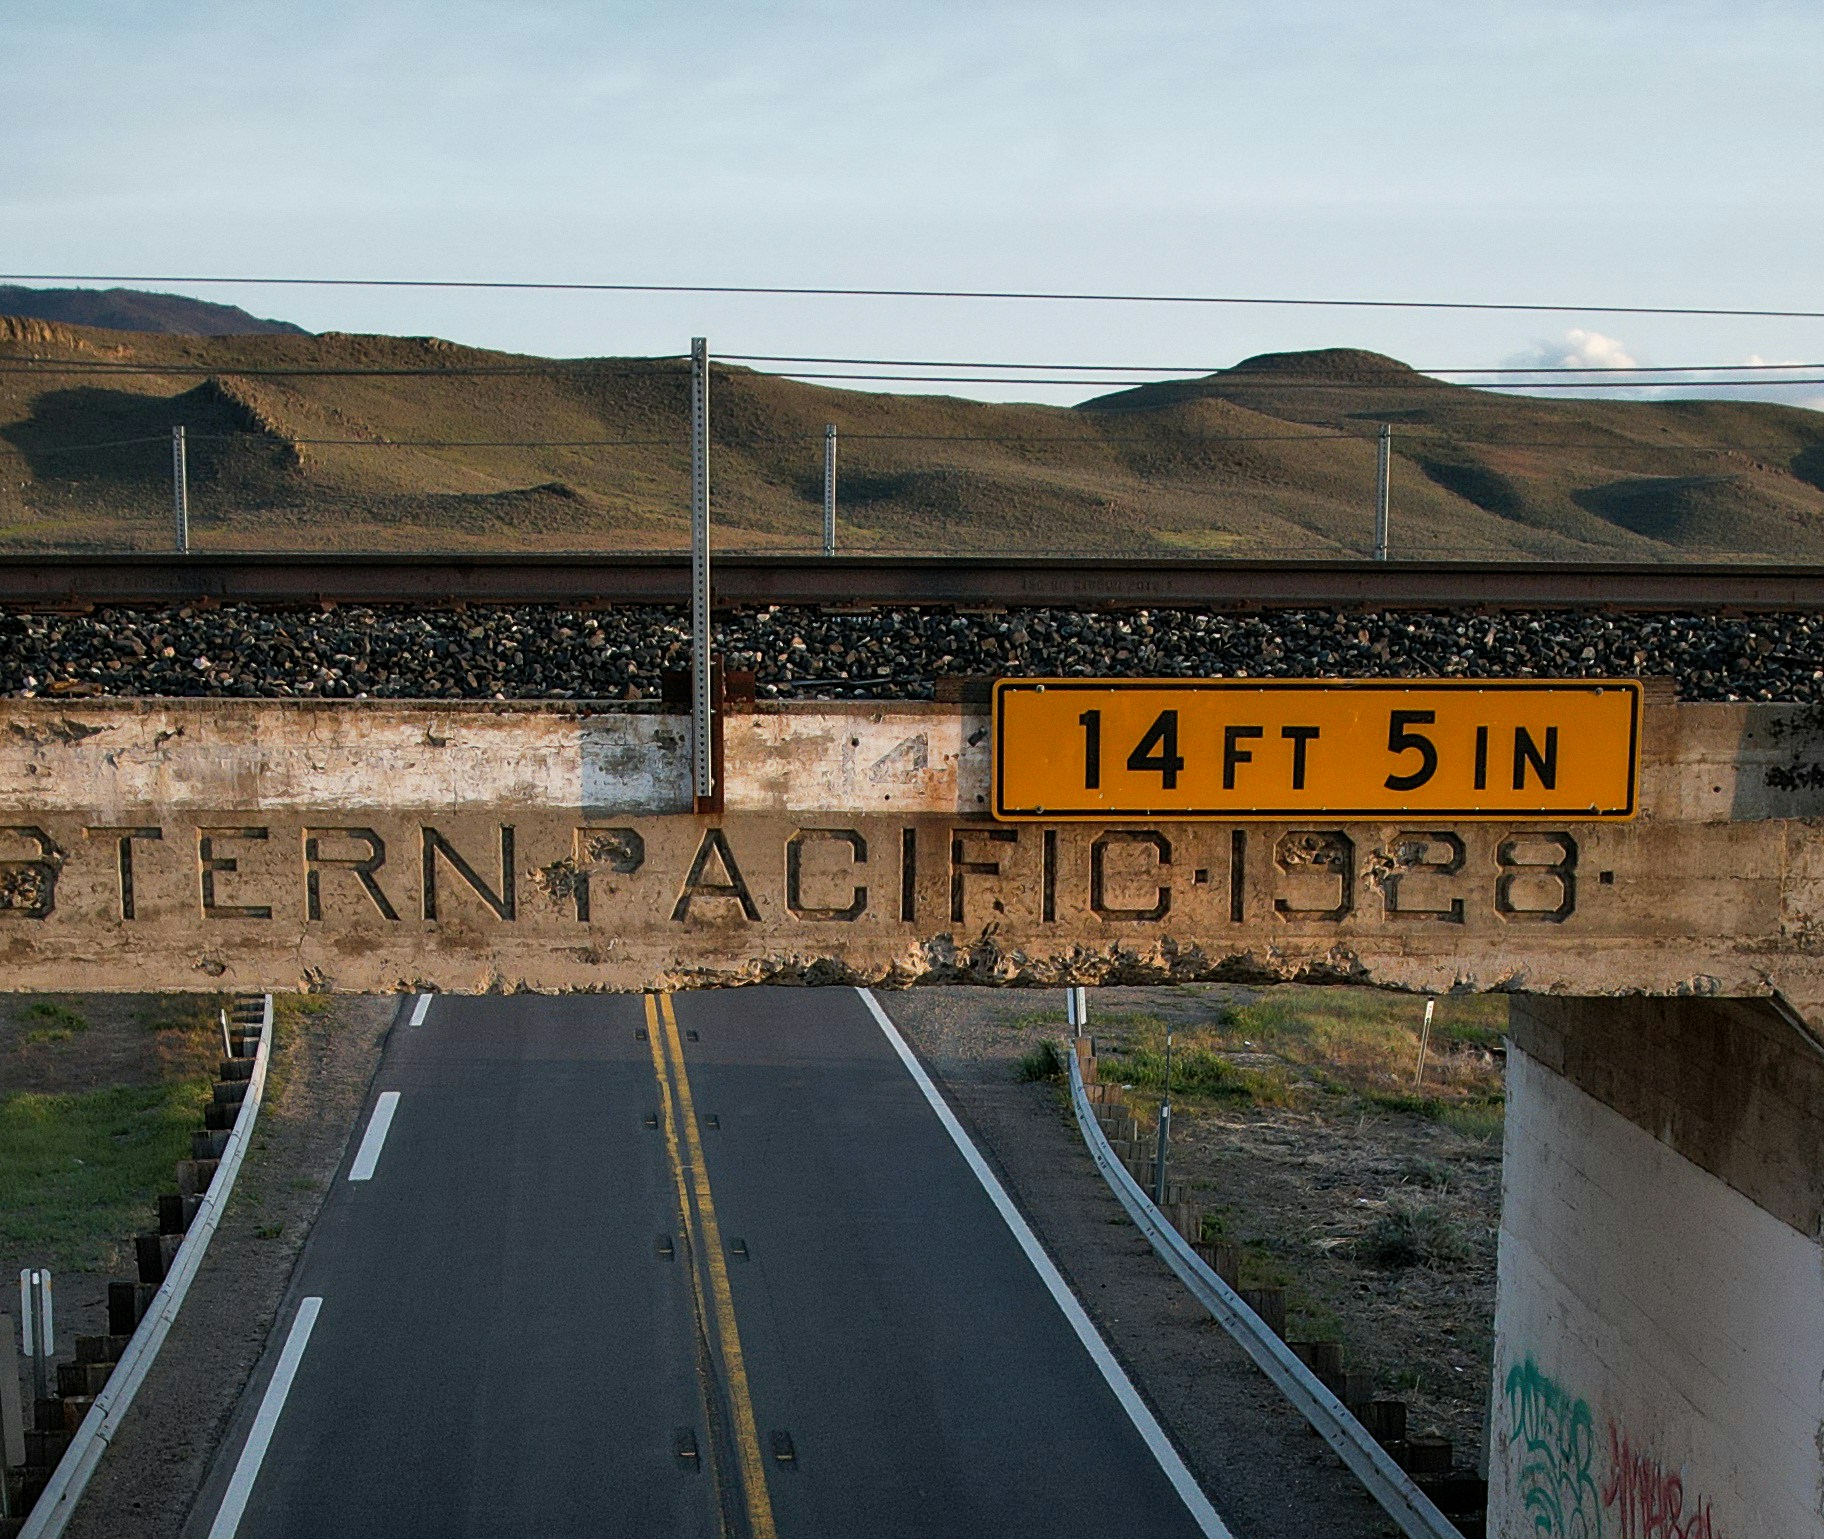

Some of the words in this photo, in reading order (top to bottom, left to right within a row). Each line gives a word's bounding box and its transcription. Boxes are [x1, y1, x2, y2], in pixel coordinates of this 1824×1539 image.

[1078, 708, 1184, 791] 14
[1222, 725, 1321, 791] FT
[1383, 709, 1438, 792] 5
[1474, 725, 1558, 791] IN
[574, 825, 1174, 924] PACIFIC
